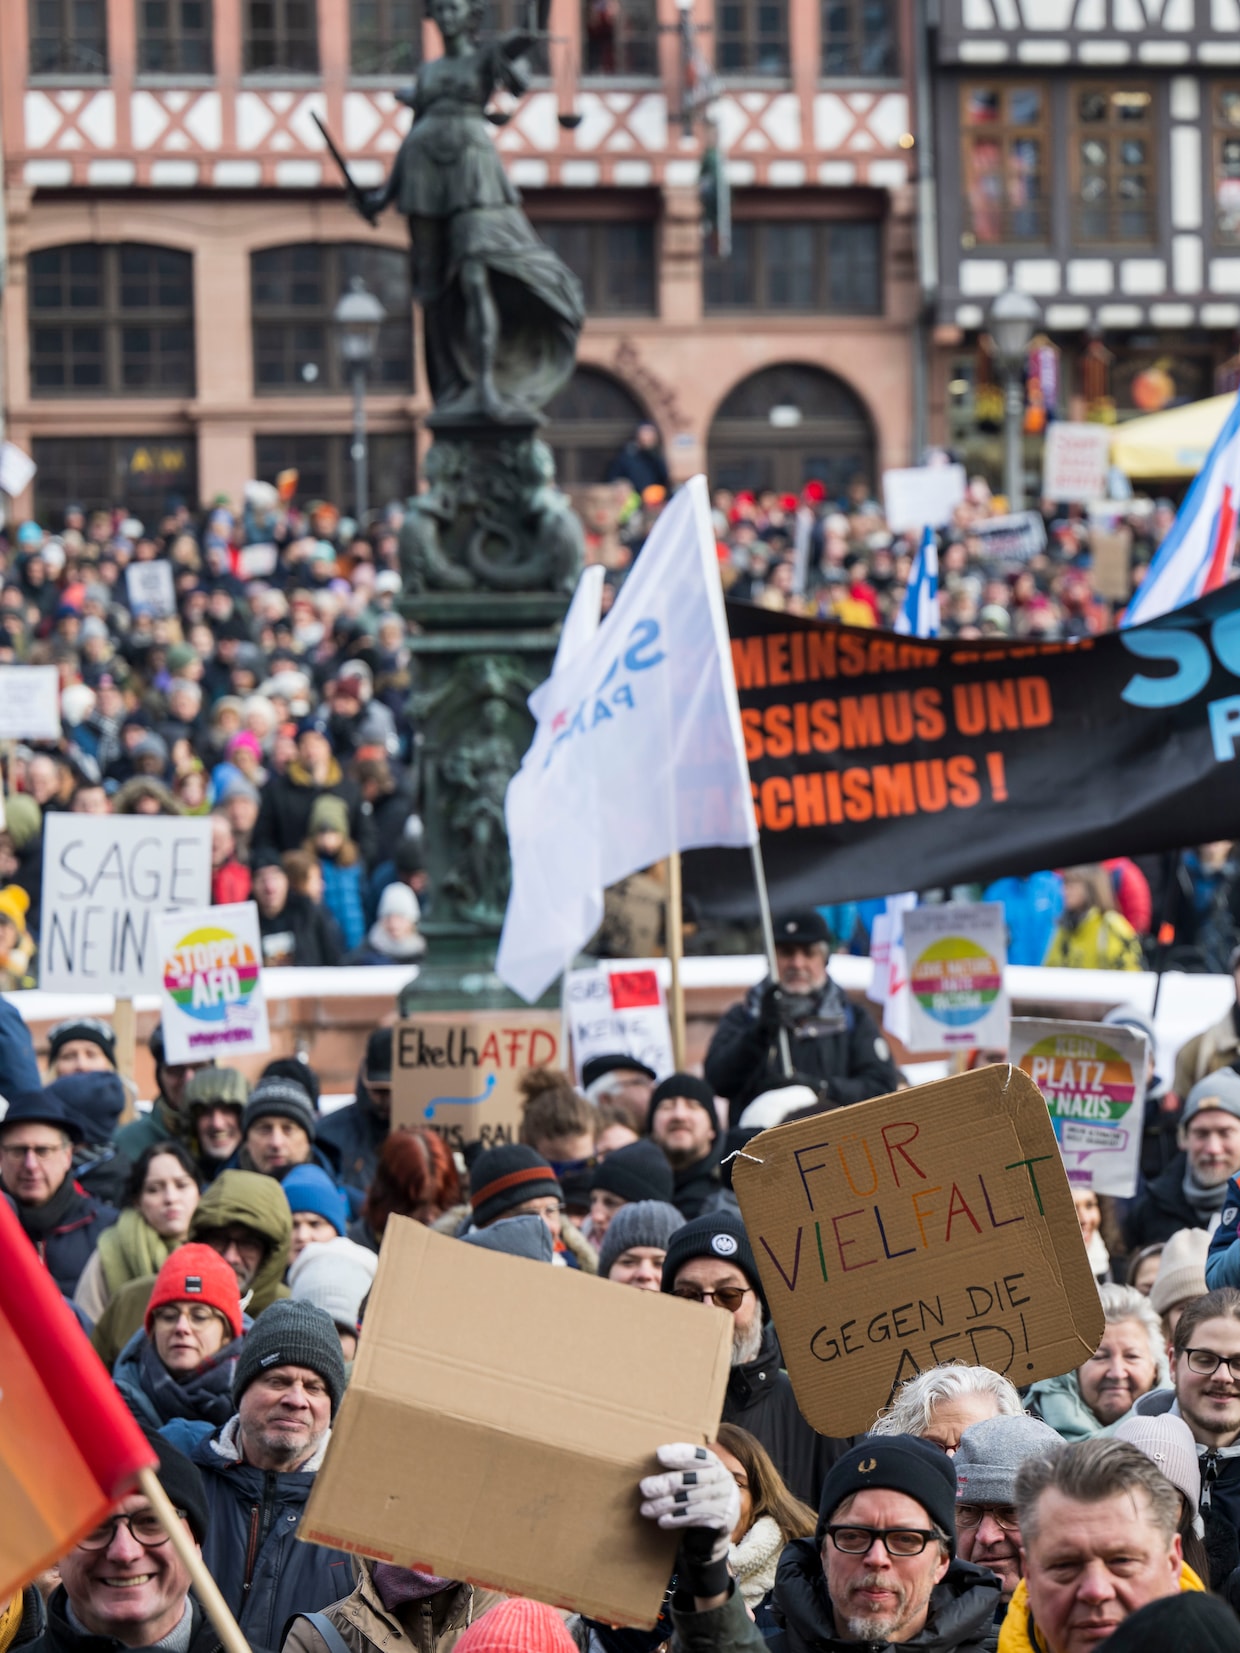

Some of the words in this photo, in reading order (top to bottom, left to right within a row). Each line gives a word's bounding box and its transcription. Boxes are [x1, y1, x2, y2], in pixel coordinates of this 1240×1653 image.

[952, 675, 1053, 736] UND
[986, 751, 1008, 802] !
[57, 836, 202, 906] SAGE
[47, 905, 150, 977] NEIN
[165, 938, 251, 978] STOPPT
[191, 966, 242, 1010] AFD
[1031, 1056, 1106, 1092] PLATZ
[1055, 1036, 1097, 1058] KEIN
[1056, 1091, 1112, 1119] NAZIS
[793, 1121, 927, 1213] FÜR
[759, 1154, 1053, 1292] VIELFALT
[809, 1295, 945, 1363] GEGEN
[966, 1273, 1031, 1321] DIE
